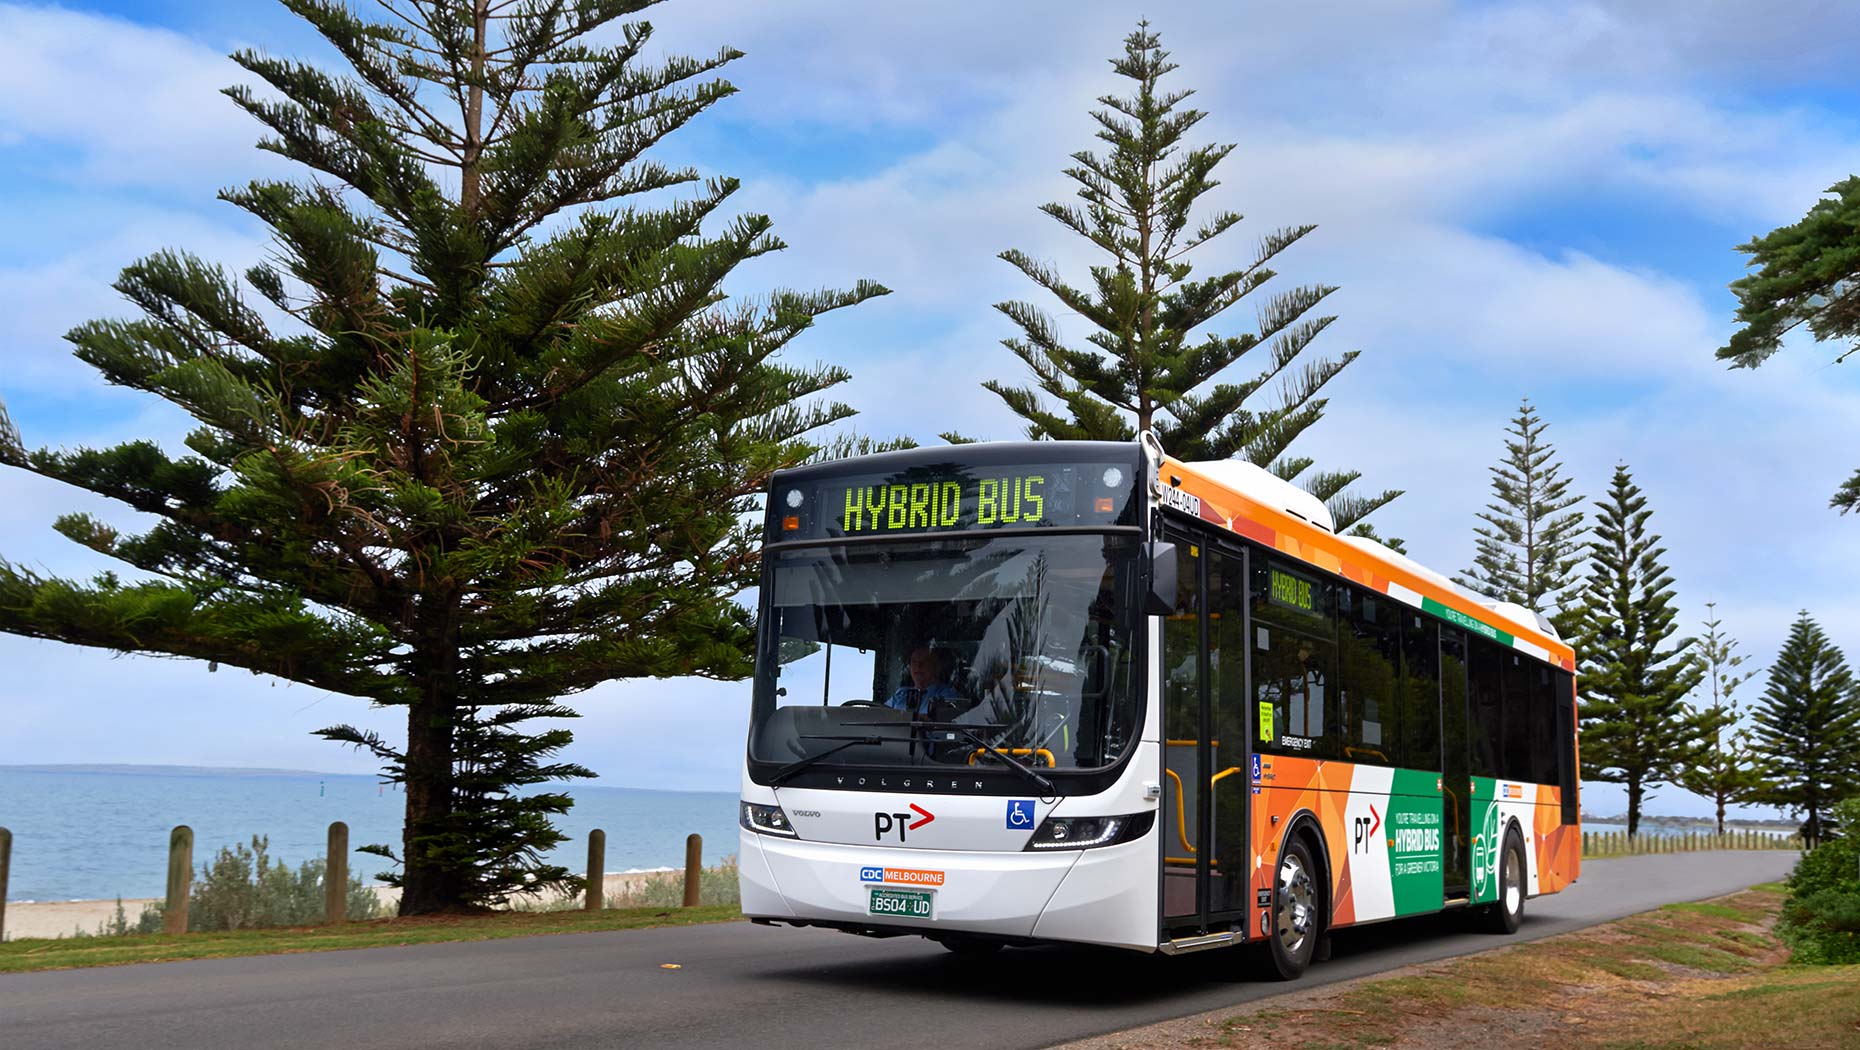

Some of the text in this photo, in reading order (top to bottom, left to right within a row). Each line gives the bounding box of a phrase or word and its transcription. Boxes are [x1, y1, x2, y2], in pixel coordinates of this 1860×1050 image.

[844, 476, 1045, 532] HYBRID BUS
[1271, 569, 1312, 610] HYBRID BUS
[1281, 735, 1312, 749] EMERGENCY EXIT
[837, 777, 983, 790] VOLGREN
[792, 809, 821, 818] VOLVO
[1395, 828, 1440, 853] HYBRID BUS
[861, 869, 943, 883] CDC MELBOURNE
[875, 897, 930, 914] BS04 UD
